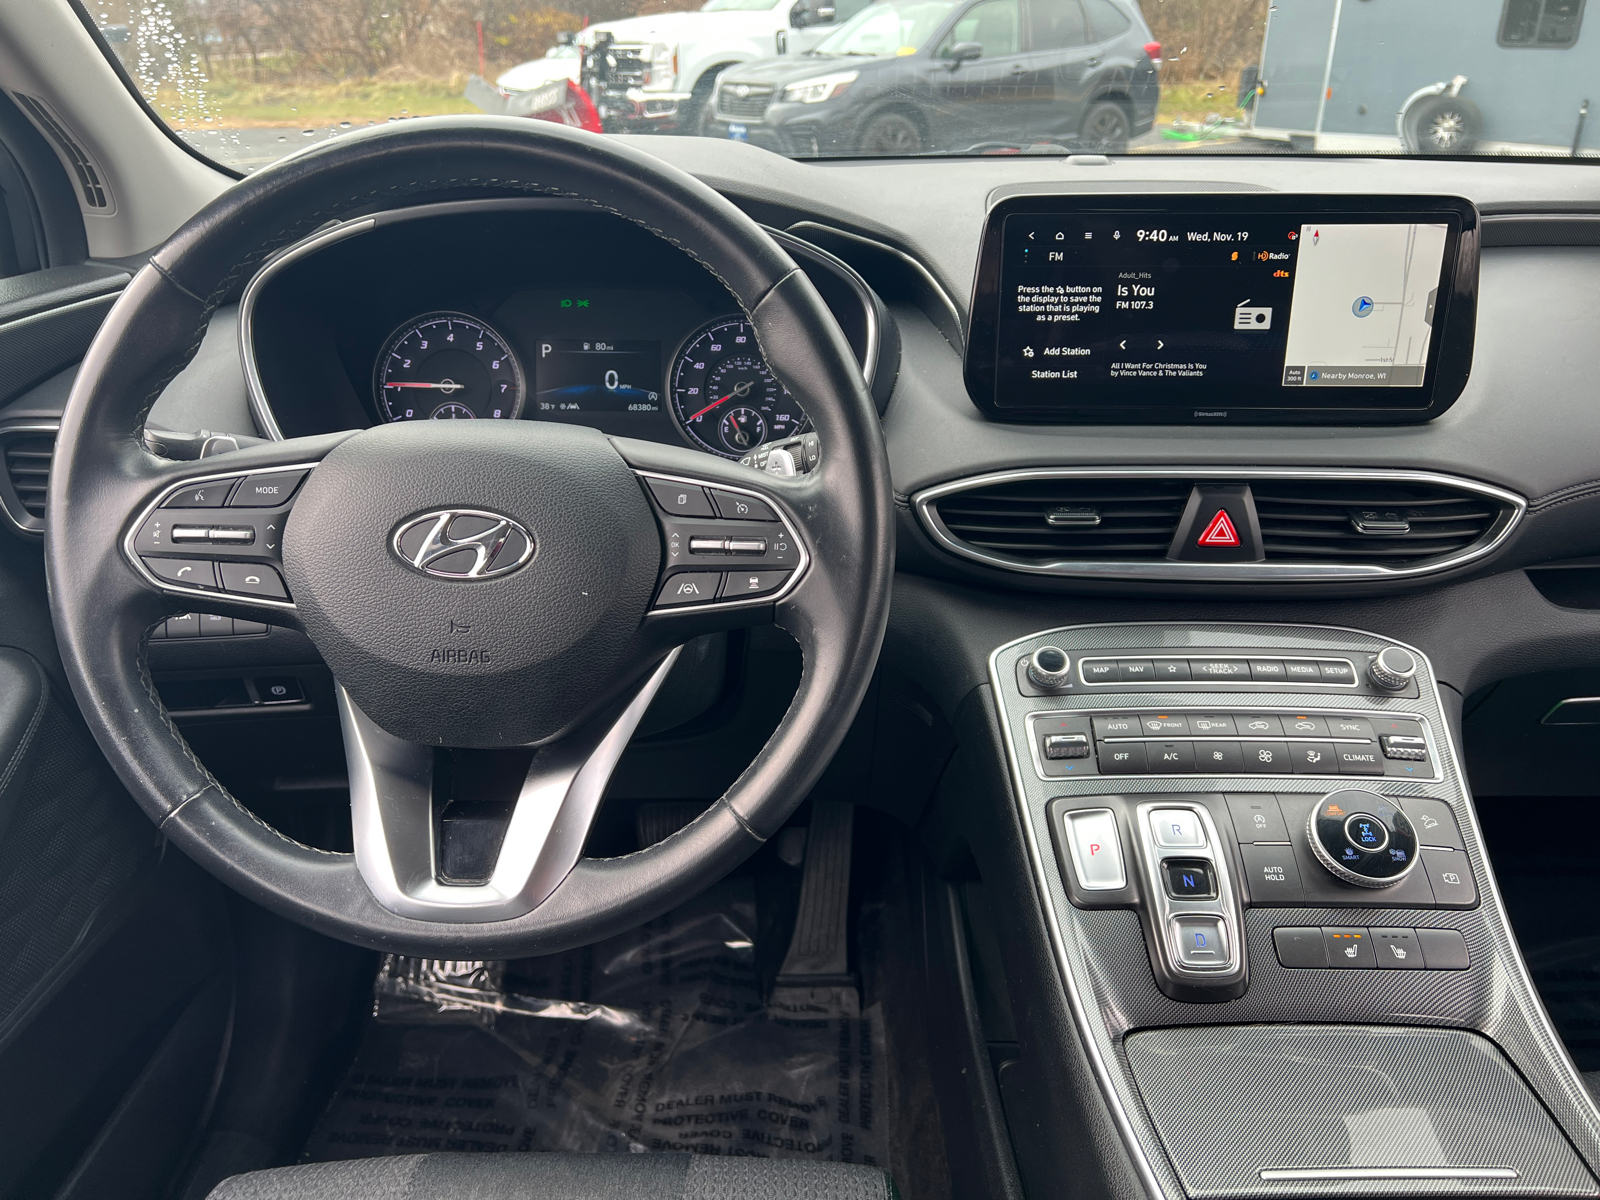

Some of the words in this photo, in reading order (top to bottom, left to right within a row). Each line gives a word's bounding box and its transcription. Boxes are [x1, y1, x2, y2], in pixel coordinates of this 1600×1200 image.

[1136, 230, 1168, 242] 9:40
[1187, 232, 1211, 243] Wed,
[1212, 232, 1235, 242] Nov.
[1237, 232, 1249, 241] 19
[1048, 252, 1064, 261] FM
[1272, 270, 1290, 278] dts
[1017, 285, 1040, 293] Press
[1117, 284, 1128, 296] Is
[1132, 284, 1156, 296] You
[1032, 295, 1059, 304] display
[1072, 304, 1100, 313] playing
[1116, 301, 1129, 309] FM
[1131, 301, 1154, 309] 107.3
[1054, 314, 1080, 322] preset.
[446, 334, 454, 342] 4
[420, 340, 428, 350] 3
[476, 342, 484, 350] 5
[542, 344, 552, 358] P
[1044, 347, 1061, 355] Add
[1062, 347, 1091, 355] Station
[403, 359, 411, 368] 2
[492, 360, 500, 370] 6
[1031, 370, 1060, 378] Station
[1061, 370, 1078, 378] List
[604, 370, 618, 390] 0
[500, 384, 508, 393] 7
[406, 409, 414, 418] 0
[493, 409, 501, 418] 8
[430, 650, 491, 663] AIRBAG
[1343, 754, 1375, 762] CLIMATE
[1172, 824, 1182, 836] R
[1090, 844, 1100, 856] P
[1183, 874, 1195, 888] N
[1195, 933, 1207, 948] D
[656, 1094, 714, 1112] DEALER
[719, 1091, 762, 1105] MUST
[653, 1109, 749, 1126] PROTECTIVE
[757, 1110, 810, 1130] COVER
